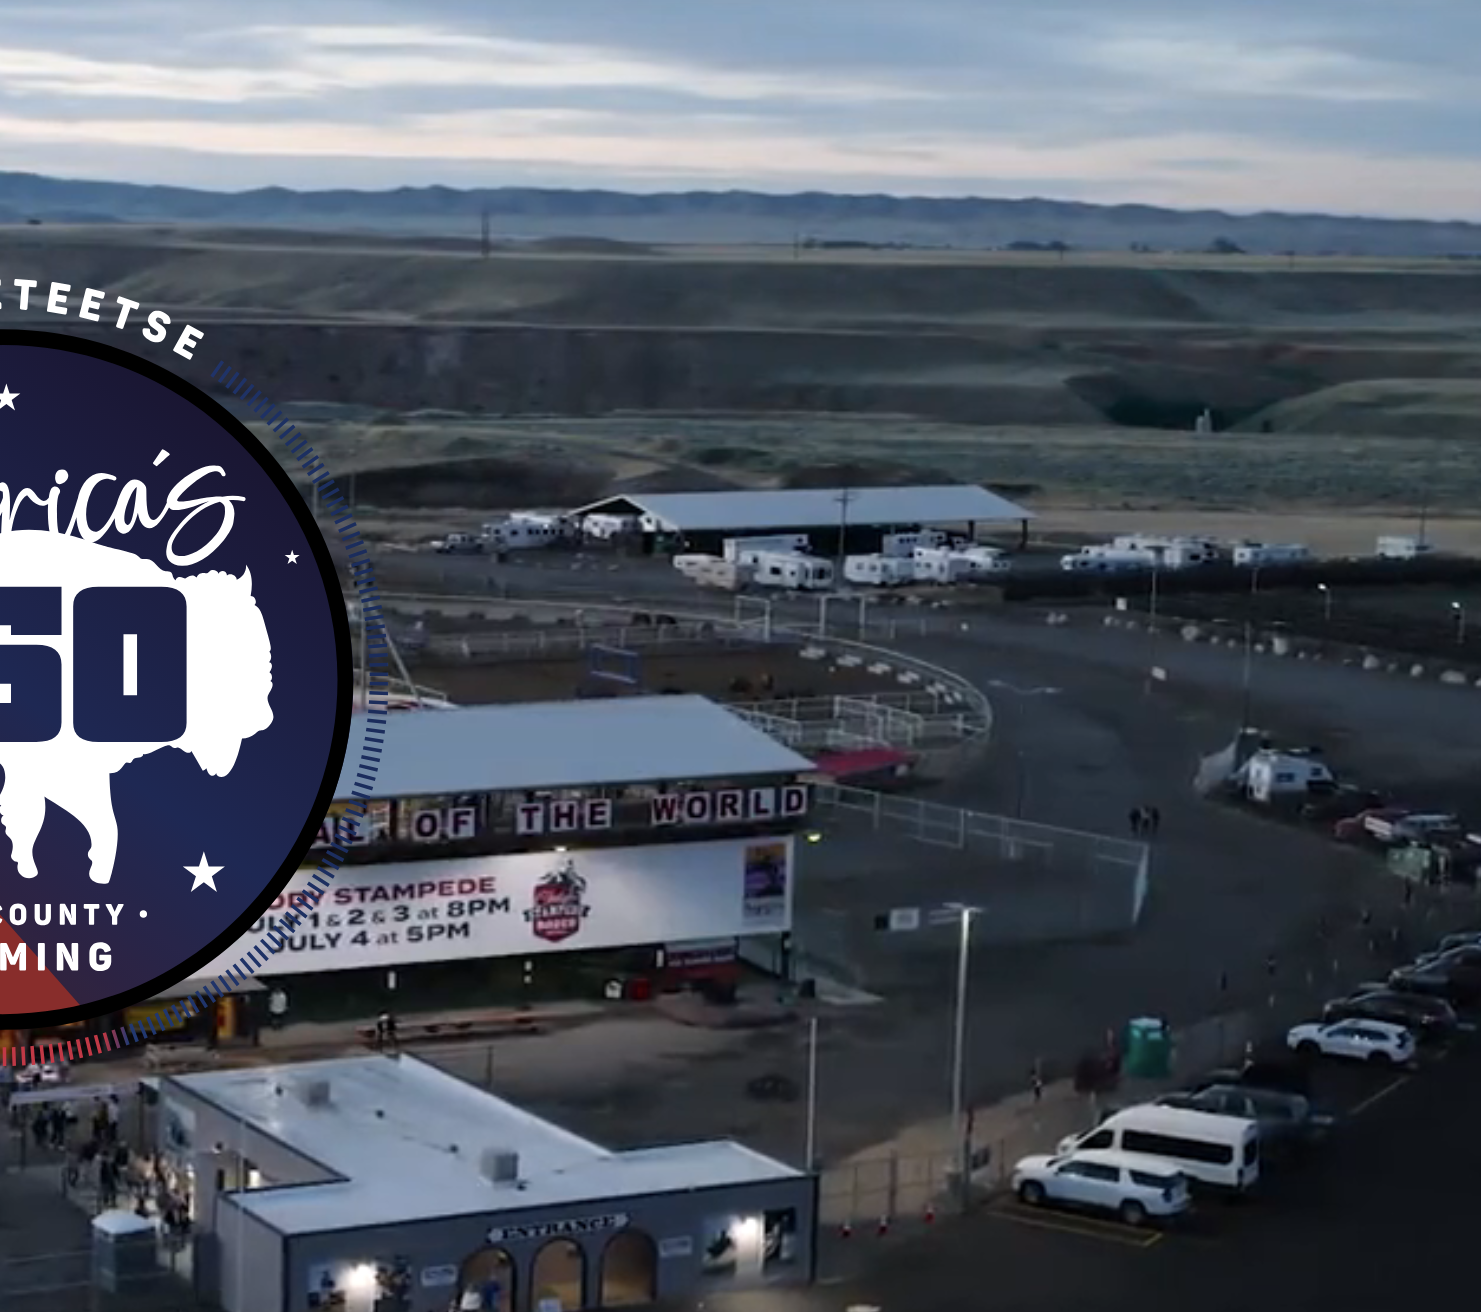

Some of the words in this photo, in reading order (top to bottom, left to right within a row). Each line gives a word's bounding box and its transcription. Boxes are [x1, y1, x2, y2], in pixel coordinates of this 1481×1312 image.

[415, 807, 471, 838] OF
[521, 802, 607, 831] THE
[653, 788, 804, 822] WORLD
[334, 876, 496, 906] STAMPEDE
[309, 912, 319, 929] 1
[326, 913, 341, 927] &
[348, 908, 366, 925] 2
[371, 909, 386, 925] &
[393, 904, 410, 922] 3
[417, 906, 440, 920] at
[447, 896, 510, 918] 8PM
[268, 931, 343, 954] JULY
[350, 930, 369, 946] 4
[376, 930, 399, 945] at
[406, 921, 470, 943] 5PM
[502, 1214, 617, 1239] ENTRANCE
